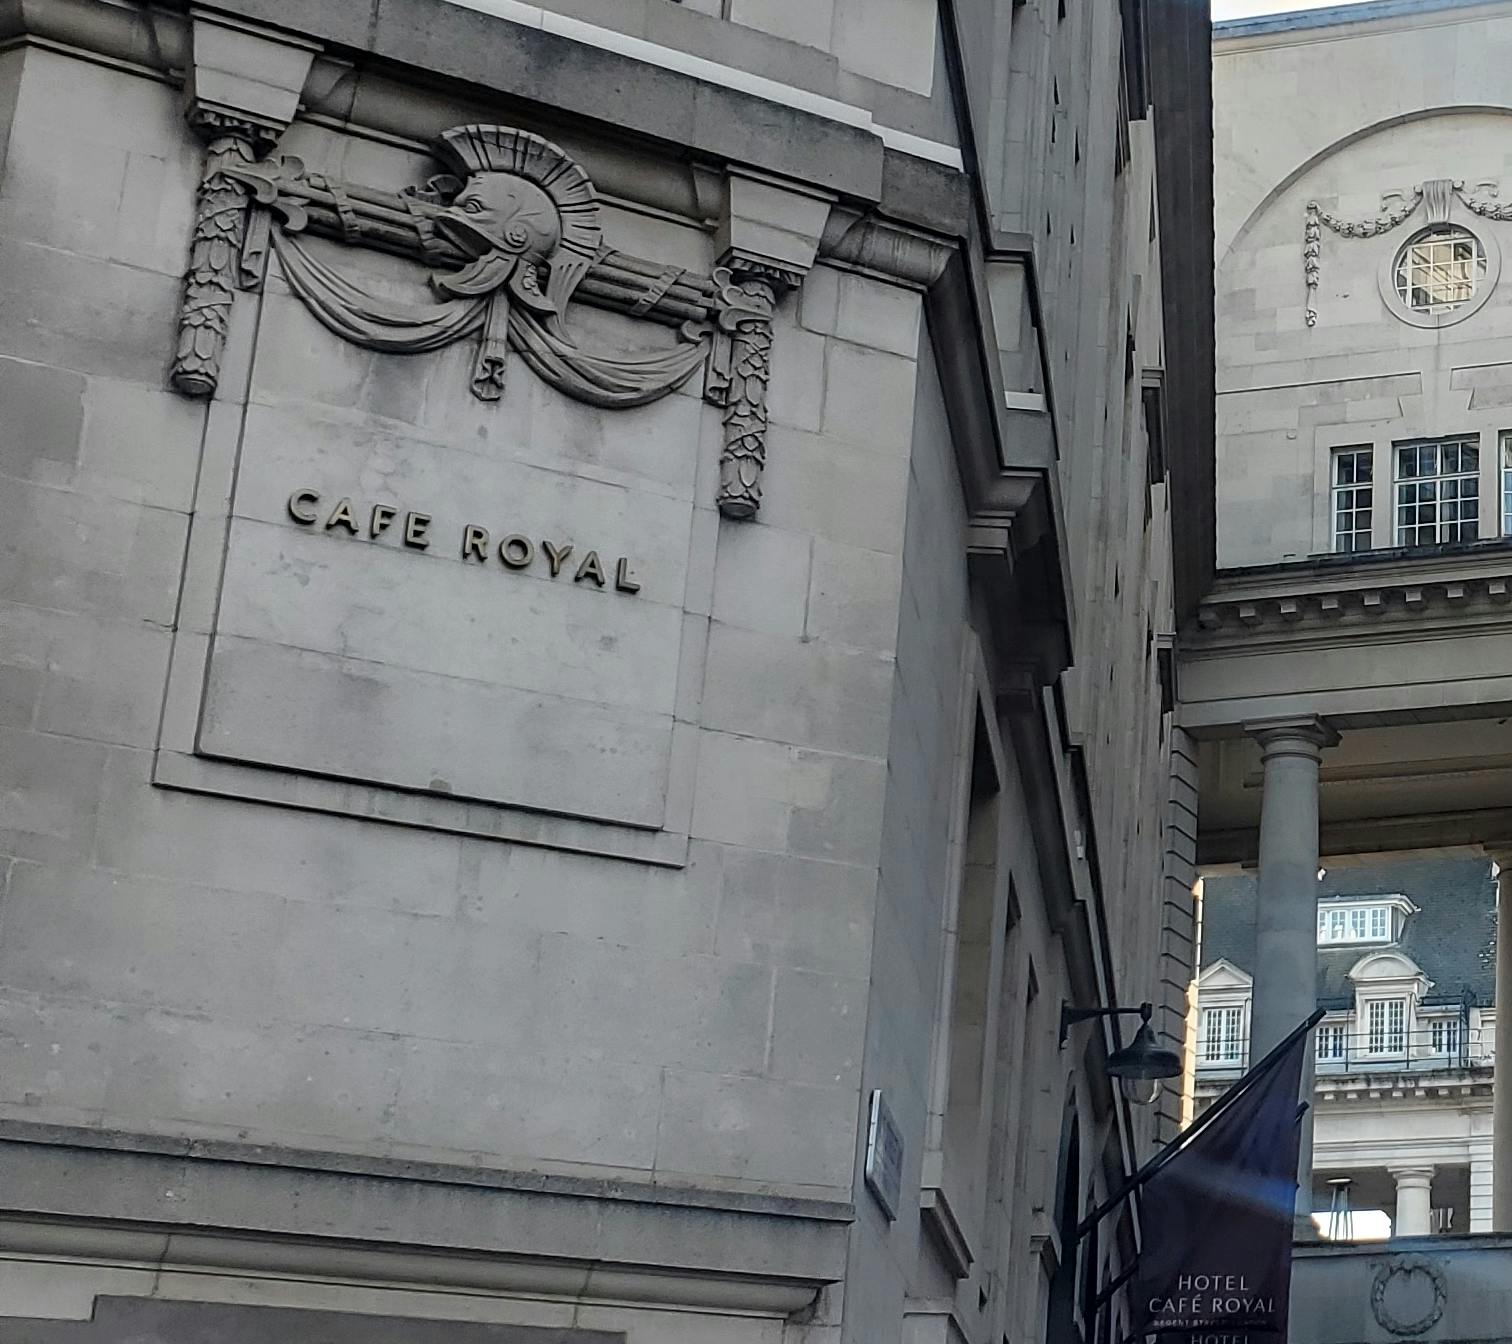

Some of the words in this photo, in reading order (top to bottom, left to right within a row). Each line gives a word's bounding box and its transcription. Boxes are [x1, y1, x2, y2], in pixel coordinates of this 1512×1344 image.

[287, 487, 432, 551] CAFE
[462, 523, 641, 594] ROYAL
[1178, 1274, 1250, 1291] HOTEL
[1149, 1293, 1202, 1313] CAFÉ
[1211, 1297, 1275, 1313] ROYAL
